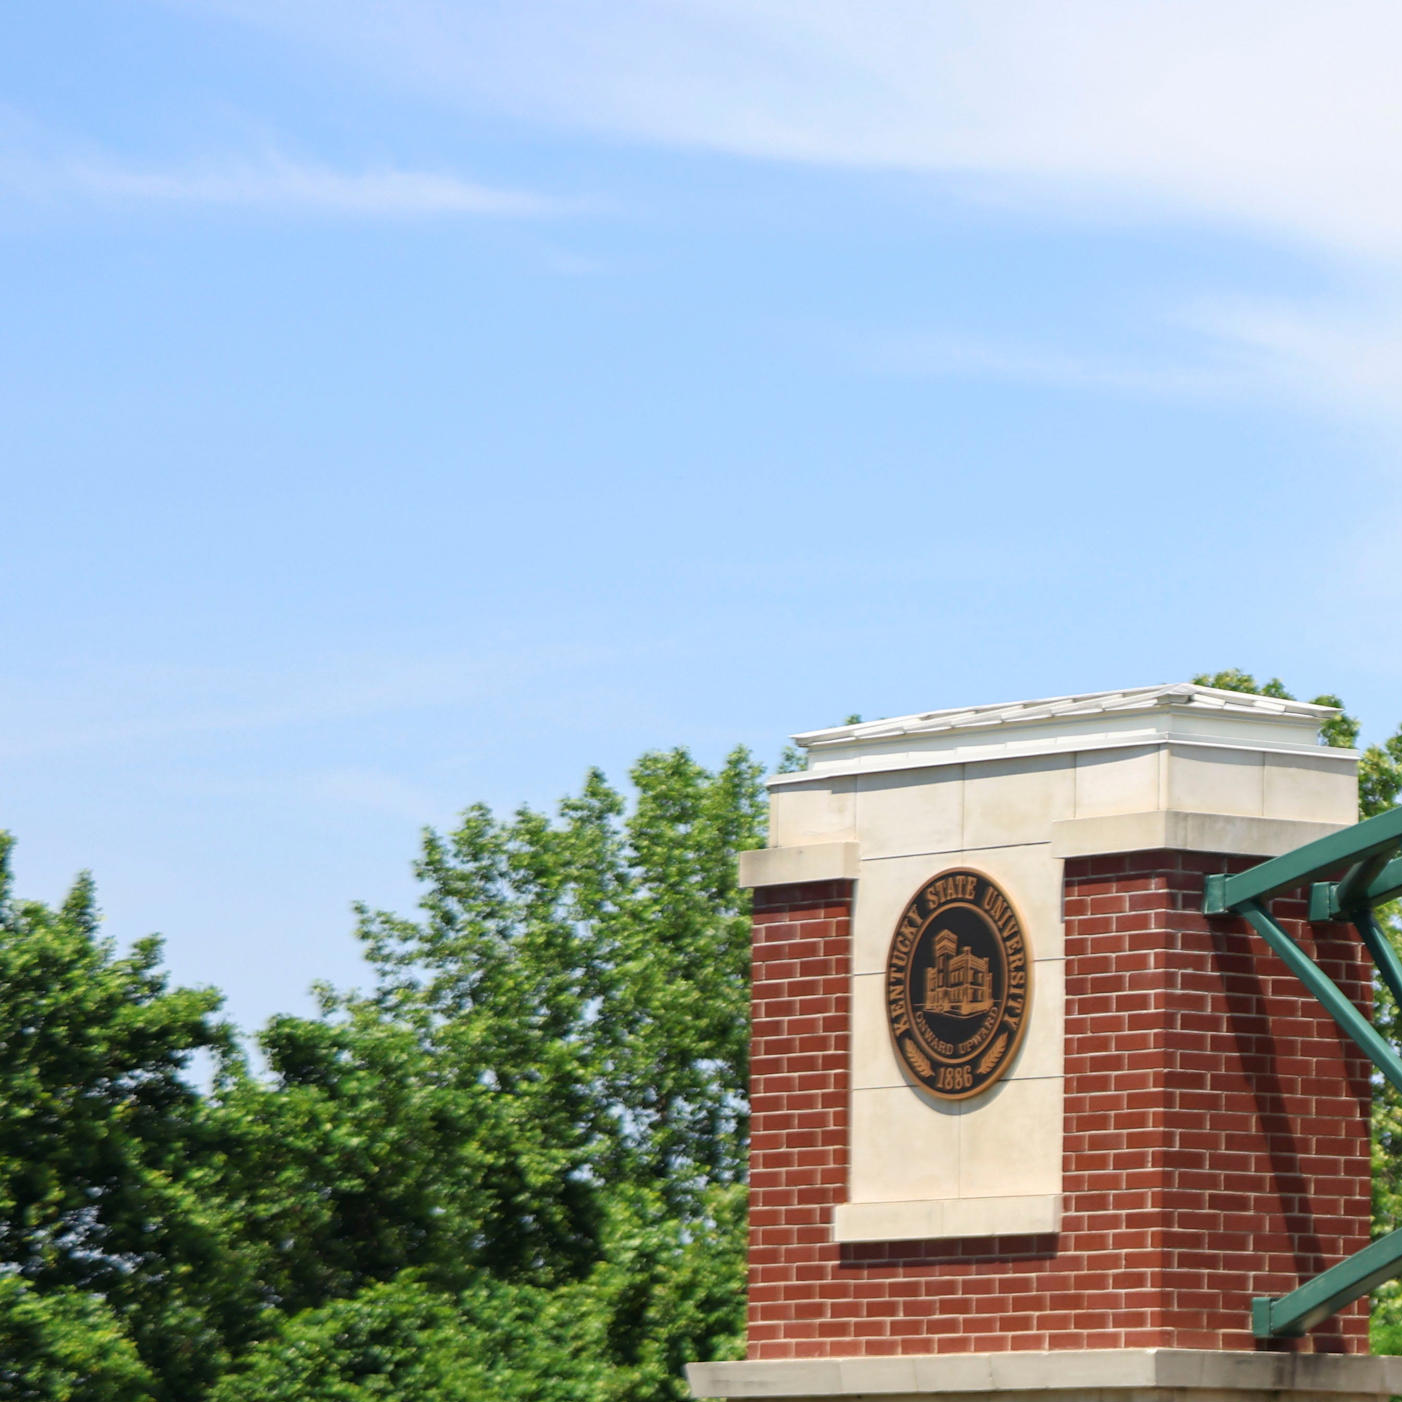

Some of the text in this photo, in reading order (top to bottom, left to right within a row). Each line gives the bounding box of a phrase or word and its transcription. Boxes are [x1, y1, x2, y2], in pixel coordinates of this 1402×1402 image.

[888, 875, 1026, 1036] KENTUCKY STATE UNIVERSITY
[914, 1006, 998, 1055] ONWARD UPWARD
[937, 1064, 974, 1090] 1886
